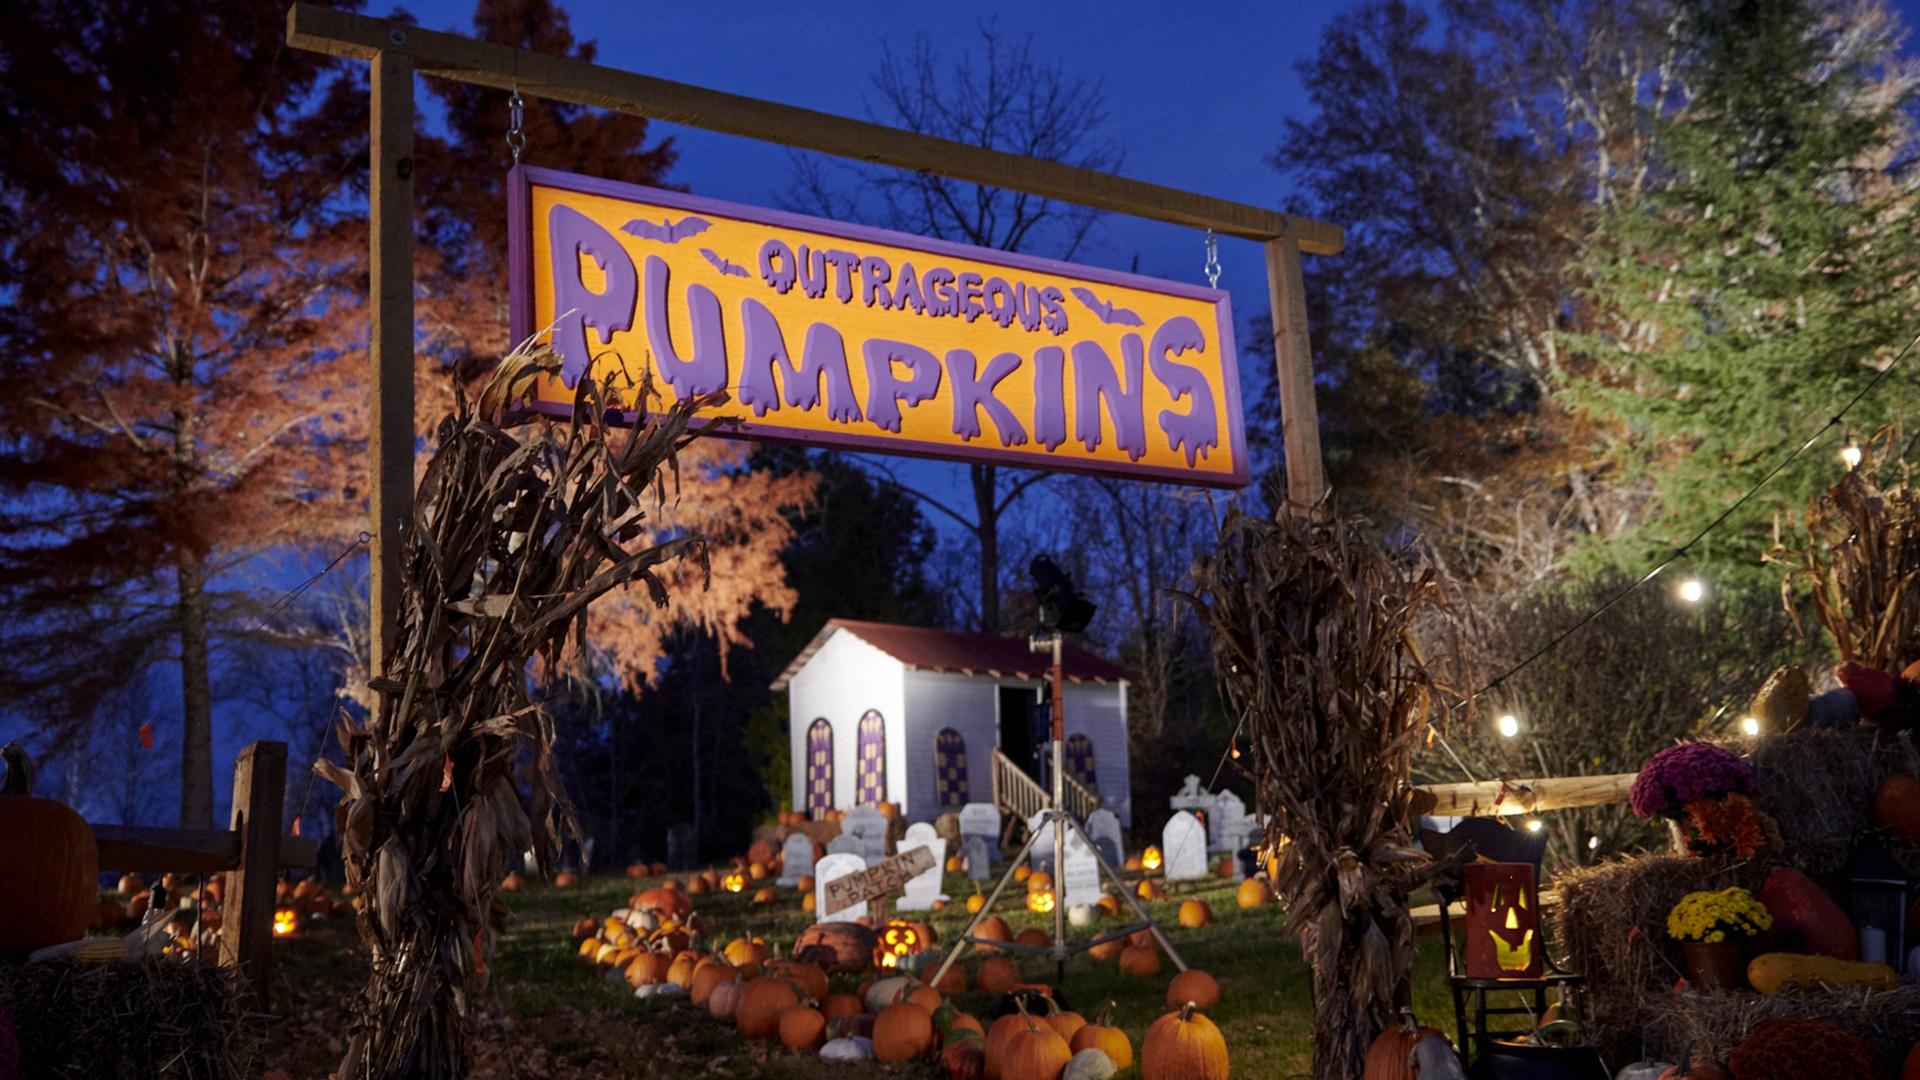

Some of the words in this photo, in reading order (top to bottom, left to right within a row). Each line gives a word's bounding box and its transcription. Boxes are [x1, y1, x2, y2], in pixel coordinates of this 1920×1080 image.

[760, 239, 1067, 335] OUTRAGEOUS
[548, 203, 1218, 468] PUMPKINS
[829, 852, 915, 898] PUMPKIN
